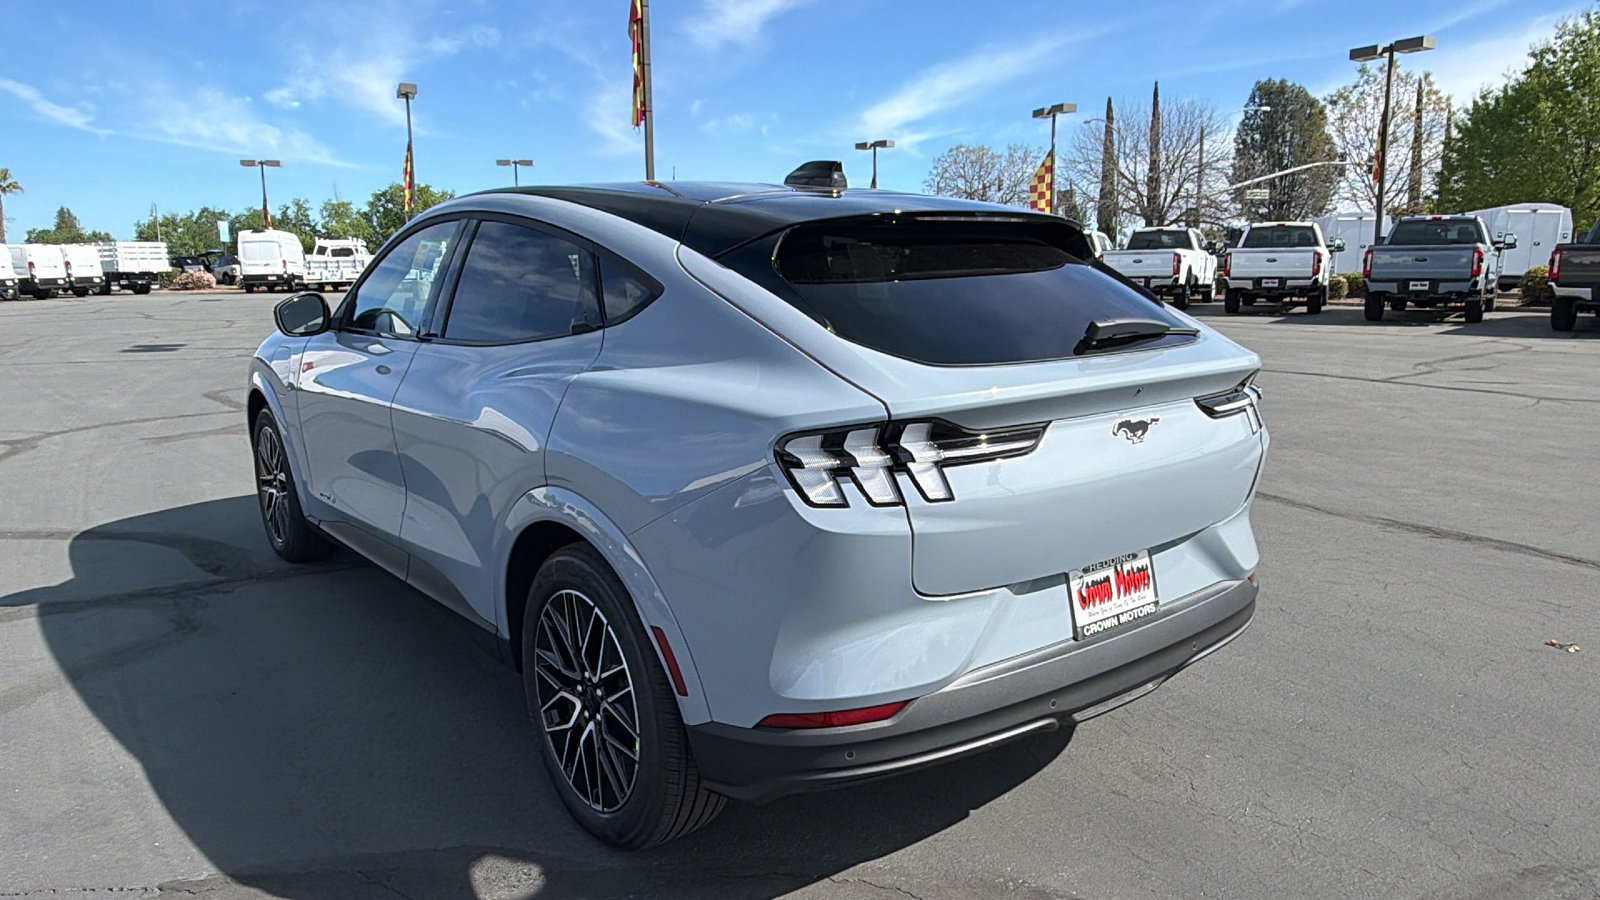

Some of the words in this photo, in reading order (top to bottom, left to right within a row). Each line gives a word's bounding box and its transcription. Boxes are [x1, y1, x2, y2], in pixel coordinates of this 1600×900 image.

[1089, 553, 1133, 572] REDDING
[1077, 575, 1113, 611] Crown
[1114, 563, 1150, 600] Motors
[1083, 616, 1118, 636] CROWN
[1119, 603, 1156, 624] MOTORS
